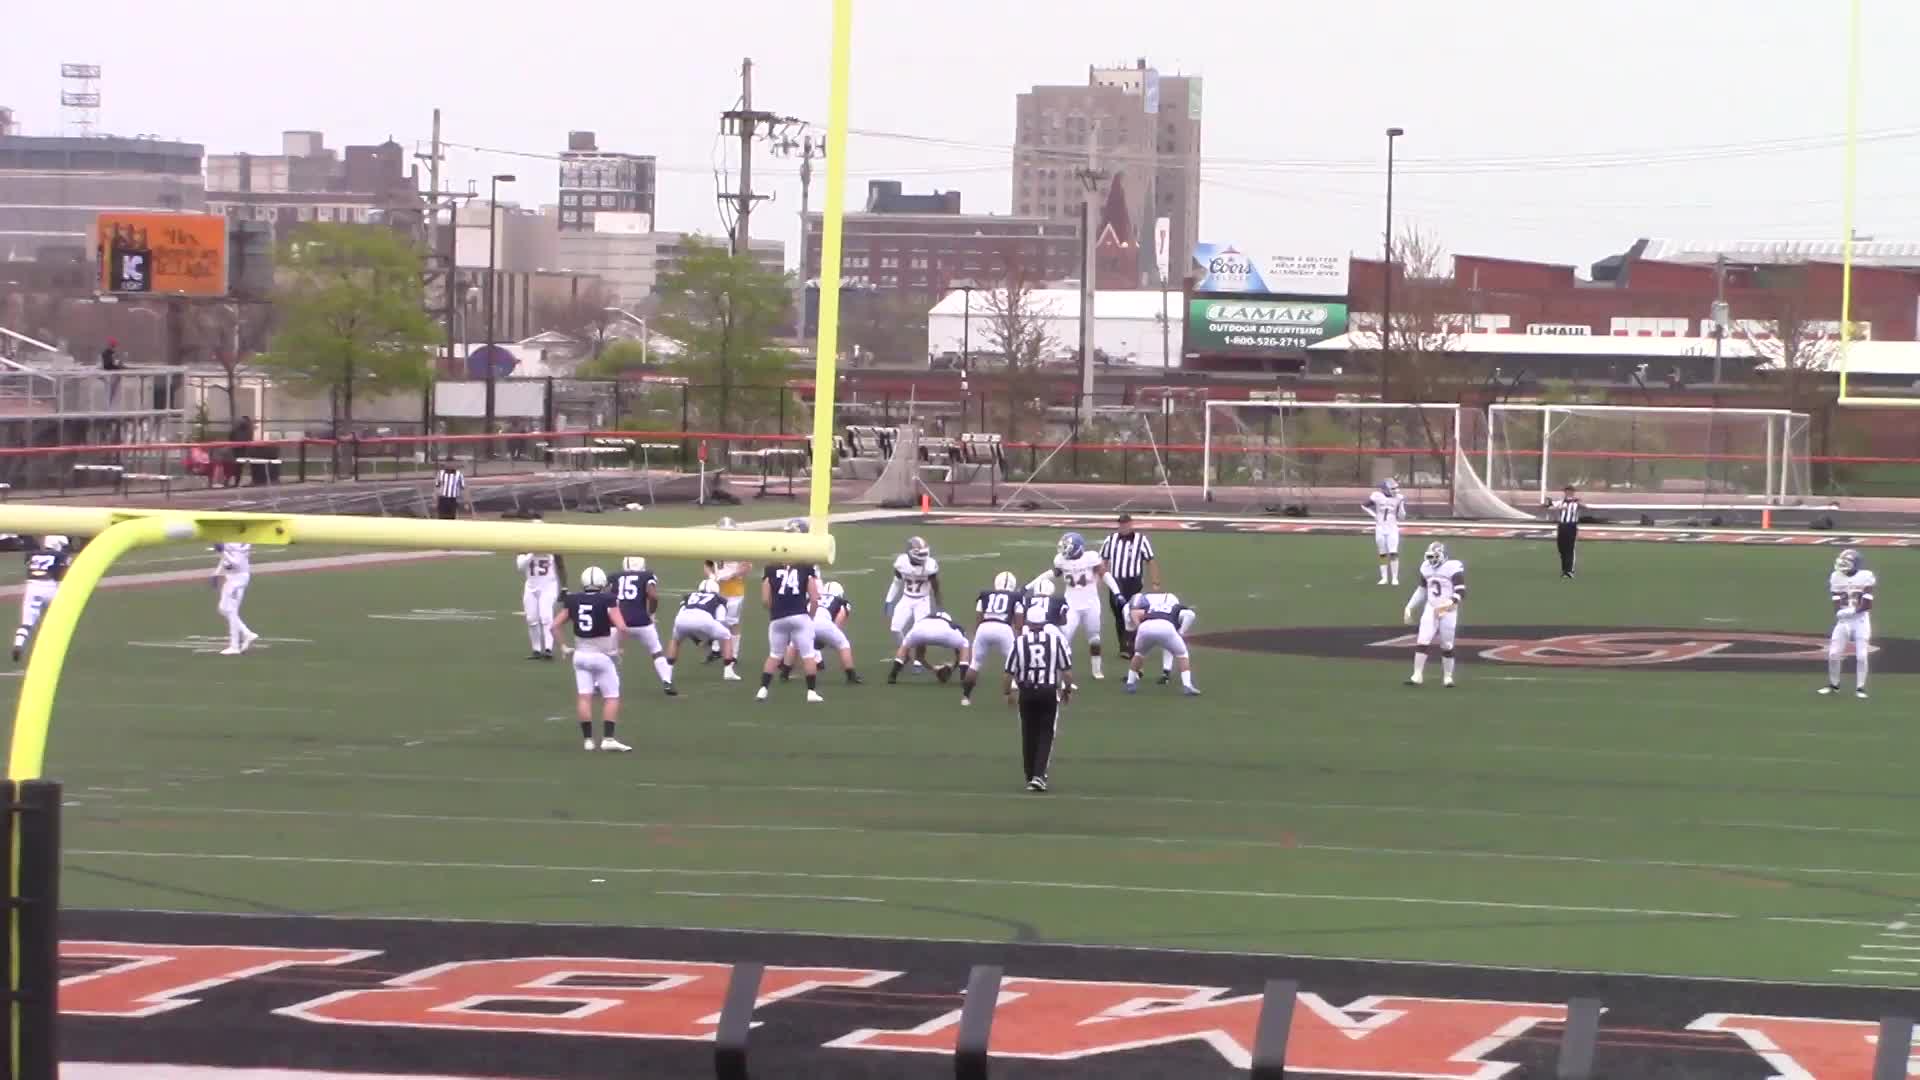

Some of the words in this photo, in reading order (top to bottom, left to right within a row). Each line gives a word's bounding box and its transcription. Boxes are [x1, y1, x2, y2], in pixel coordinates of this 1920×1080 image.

[1209, 257, 1252, 274] Coors
[1218, 307, 1314, 321] LAMAR
[1209, 323, 1257, 333] OUTDOOR
[1259, 325, 1324, 336] ADVERTISING
[529, 559, 550, 576] 15
[616, 575, 639, 600] 15
[775, 568, 800, 595] 74
[1431, 579, 1442, 597] 3
[986, 593, 1009, 613] 10
[577, 604, 593, 632] 5
[1028, 644, 1047, 668] R
